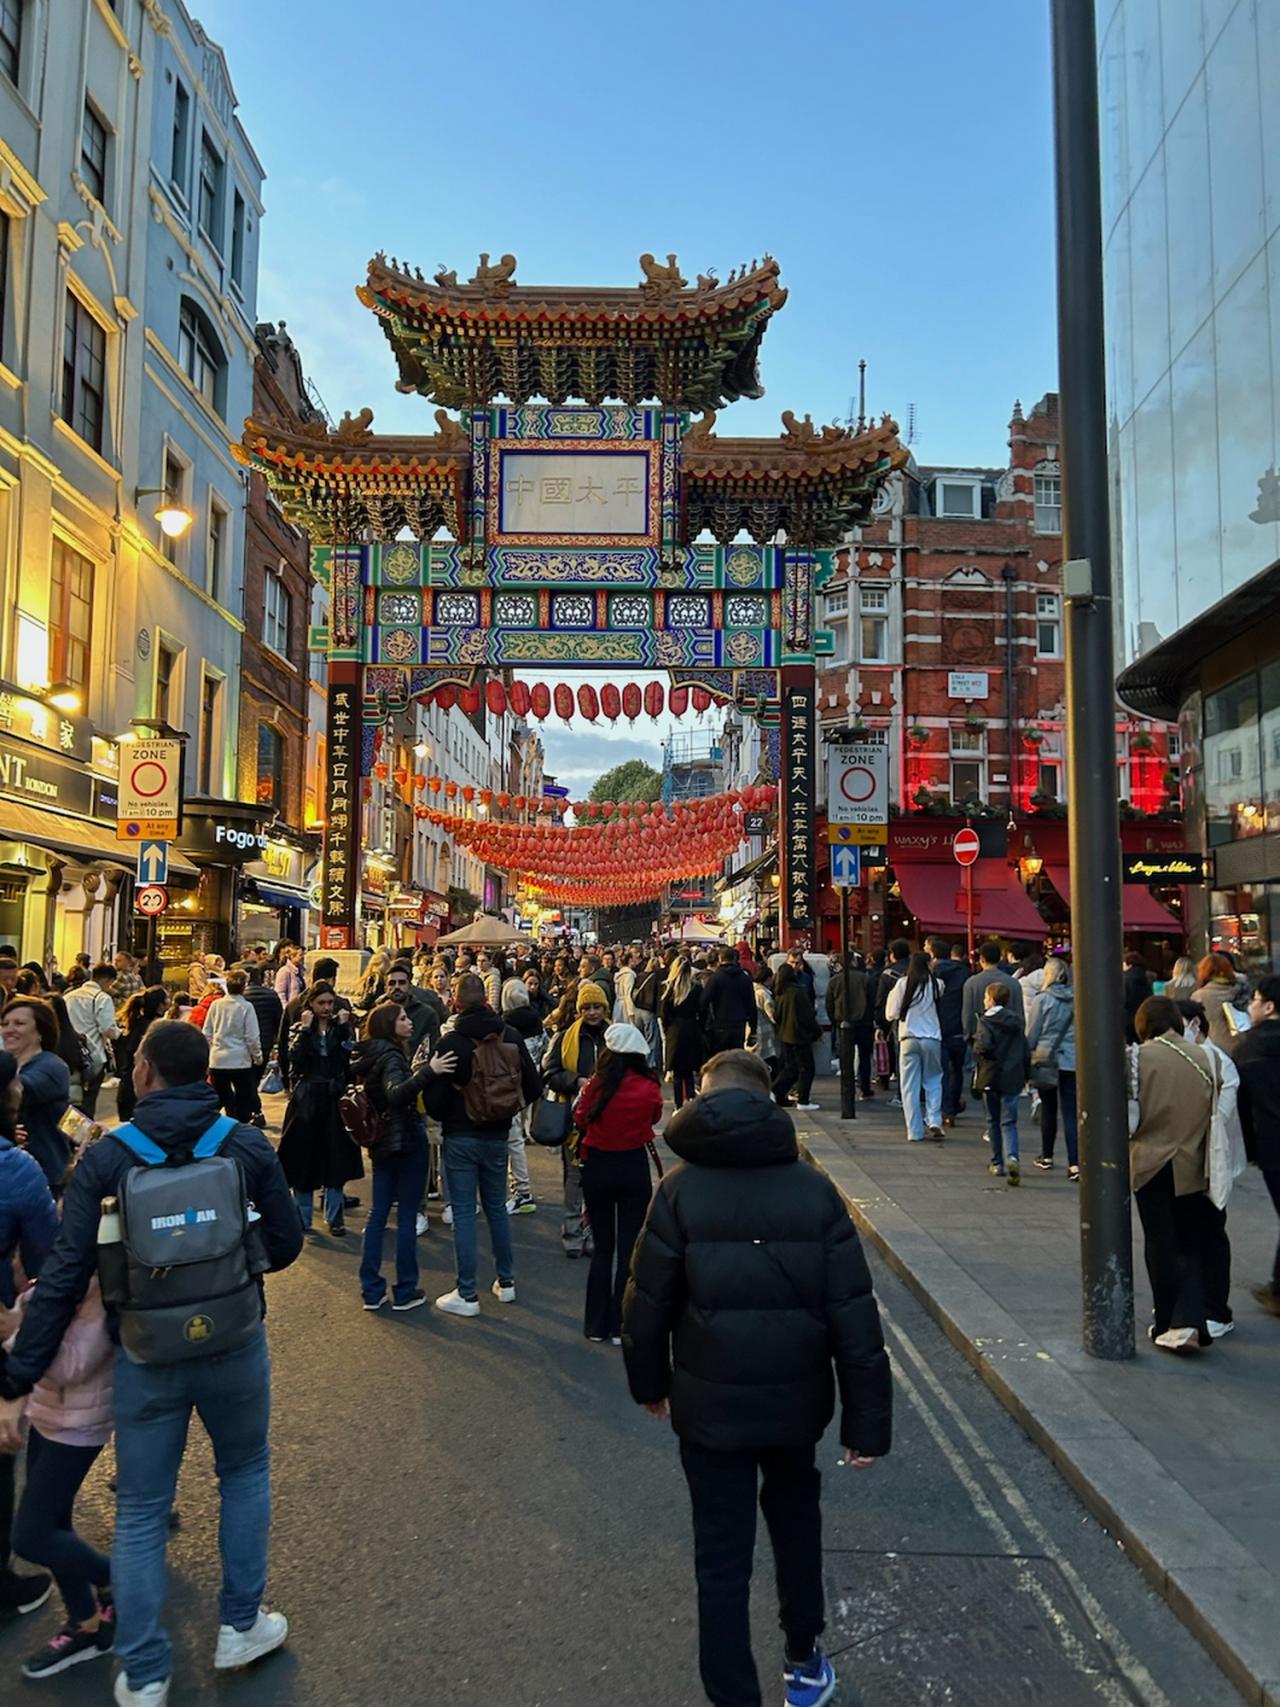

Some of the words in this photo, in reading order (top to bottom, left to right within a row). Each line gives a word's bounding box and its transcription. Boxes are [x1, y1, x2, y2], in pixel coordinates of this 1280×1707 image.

[505, 473, 643, 507] 中國太平
[133, 750, 167, 759] ZONE
[840, 755, 875, 764] ZONE
[25, 777, 58, 797] LONDON
[750, 817, 763, 828] 22
[215, 826, 255, 849] Fogo
